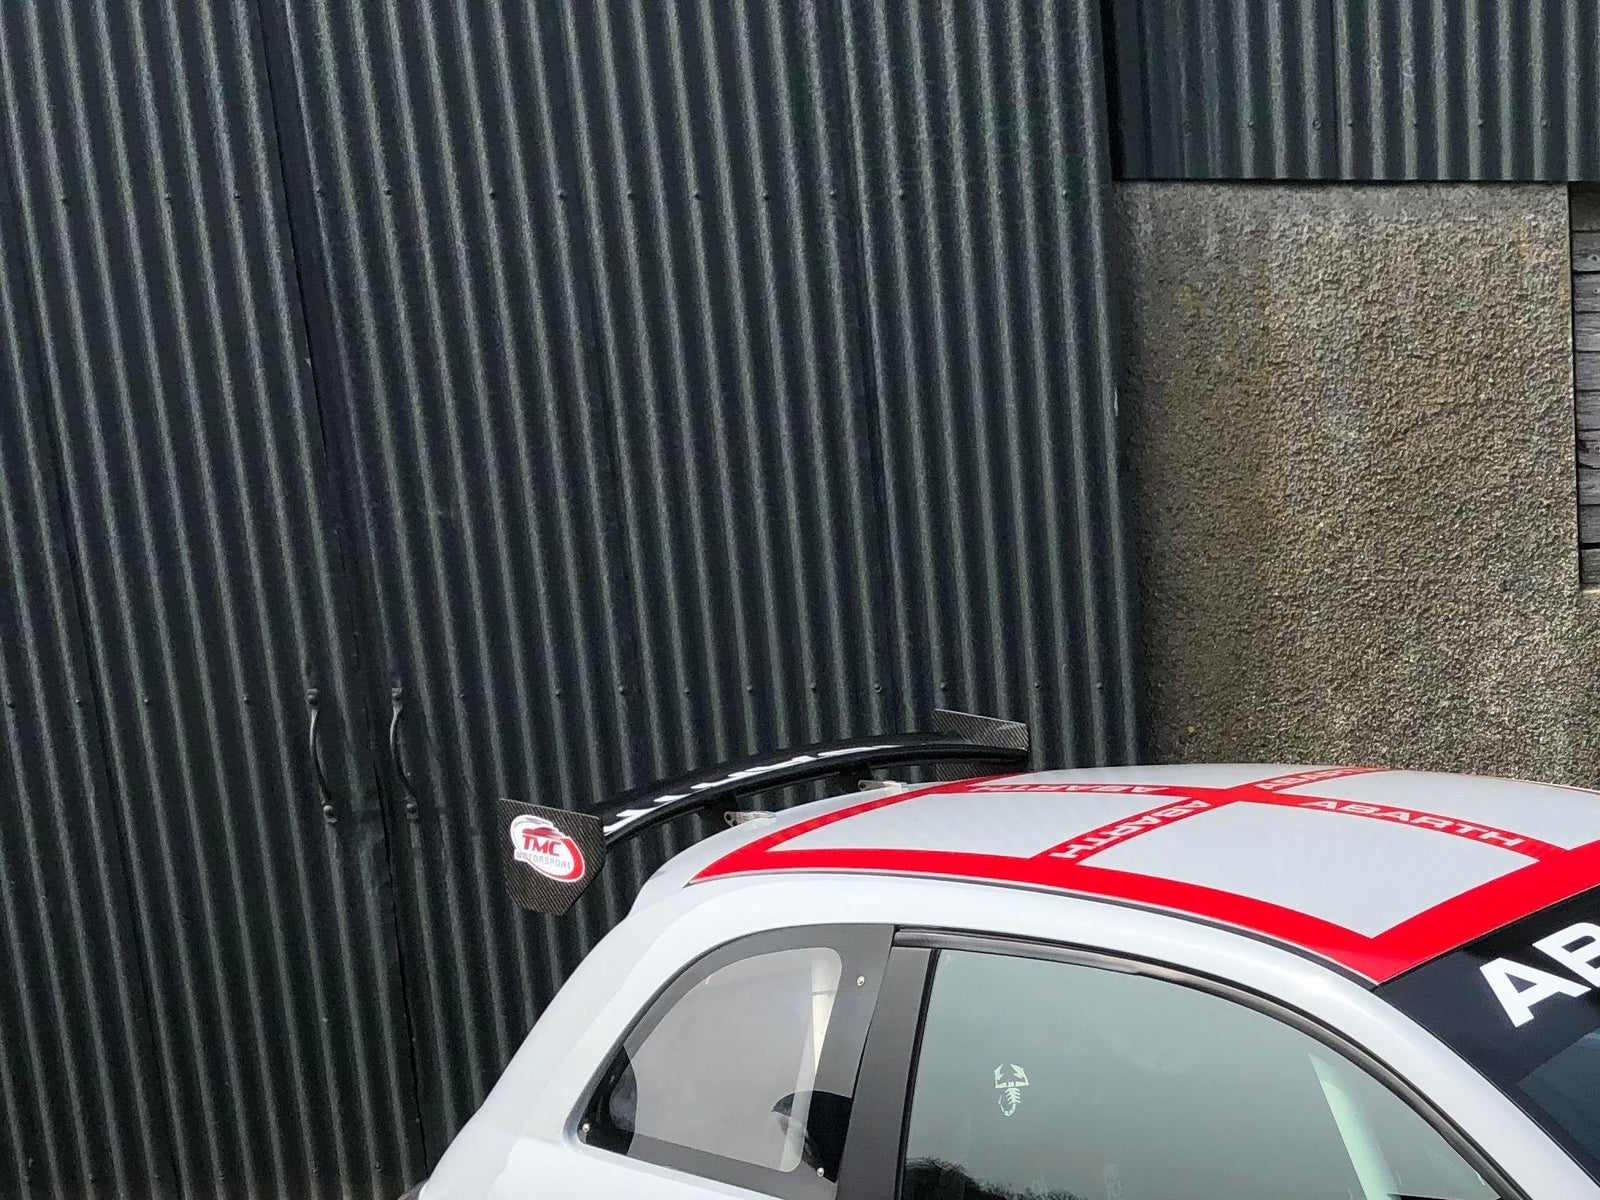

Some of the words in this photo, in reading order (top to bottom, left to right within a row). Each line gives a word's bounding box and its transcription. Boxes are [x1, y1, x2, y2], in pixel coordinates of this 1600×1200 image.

[522, 834, 562, 857] TMC
[1050, 799, 1212, 859] ABARTH
[1298, 800, 1527, 848] ABARTH
